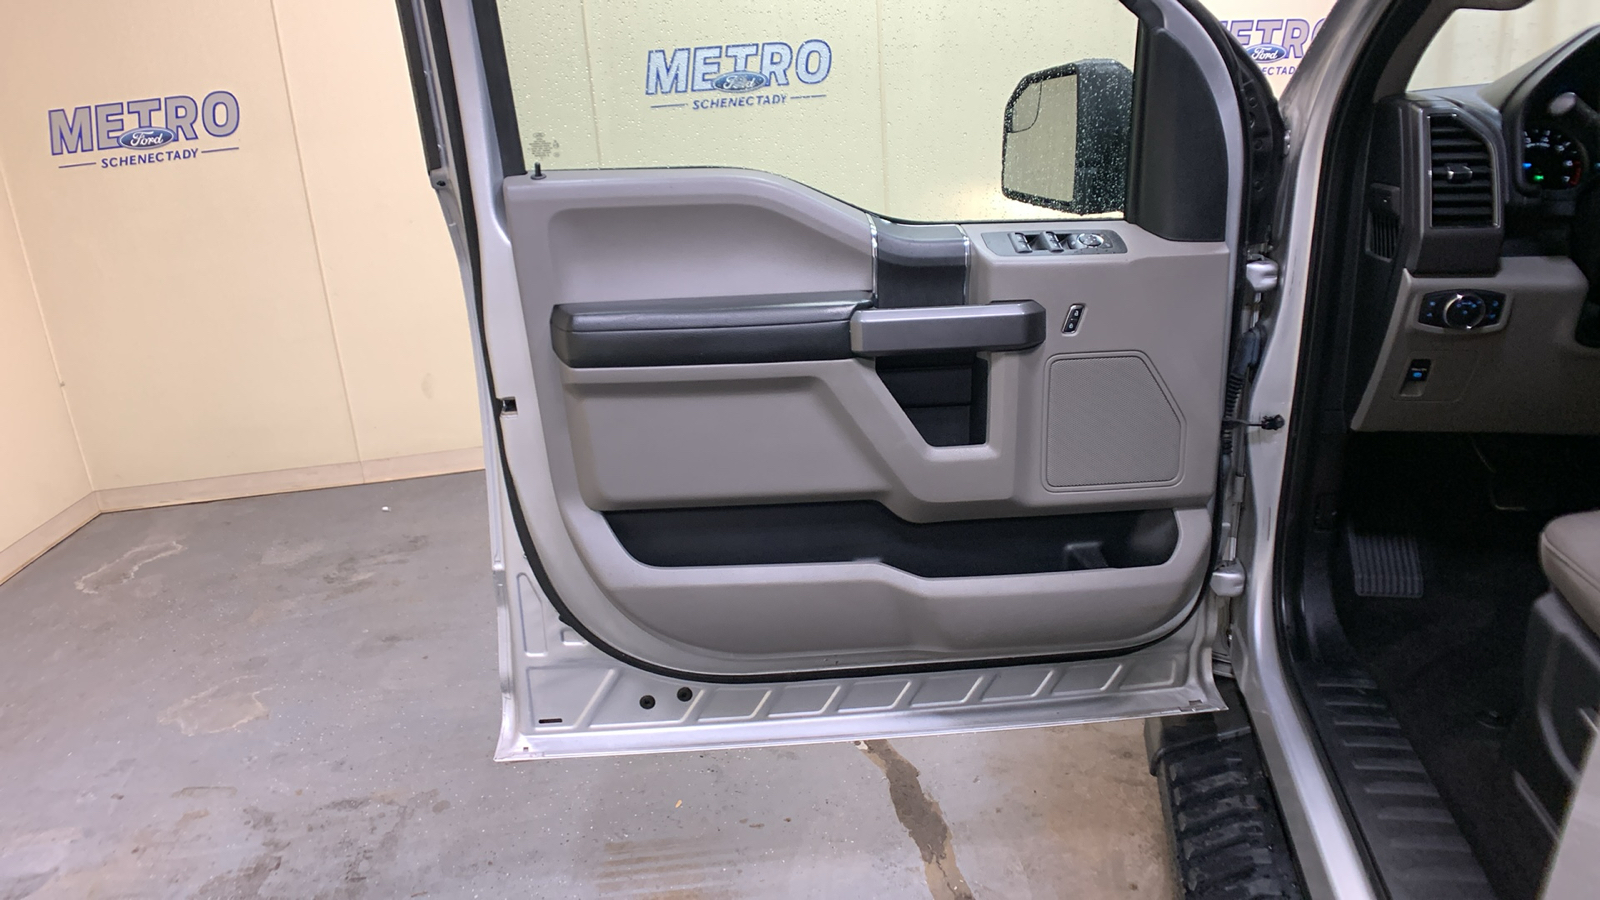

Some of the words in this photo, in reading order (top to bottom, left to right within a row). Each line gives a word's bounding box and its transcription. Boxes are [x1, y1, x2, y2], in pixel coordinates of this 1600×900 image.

[1219, 18, 1325, 59] ETR
[645, 39, 832, 95] METRO
[722, 77, 757, 91] Ford
[692, 94, 787, 110] SCHENECTADY
[48, 90, 240, 155] METRO
[130, 131, 164, 147] Ford
[101, 148, 199, 168] SCHENECTADY
